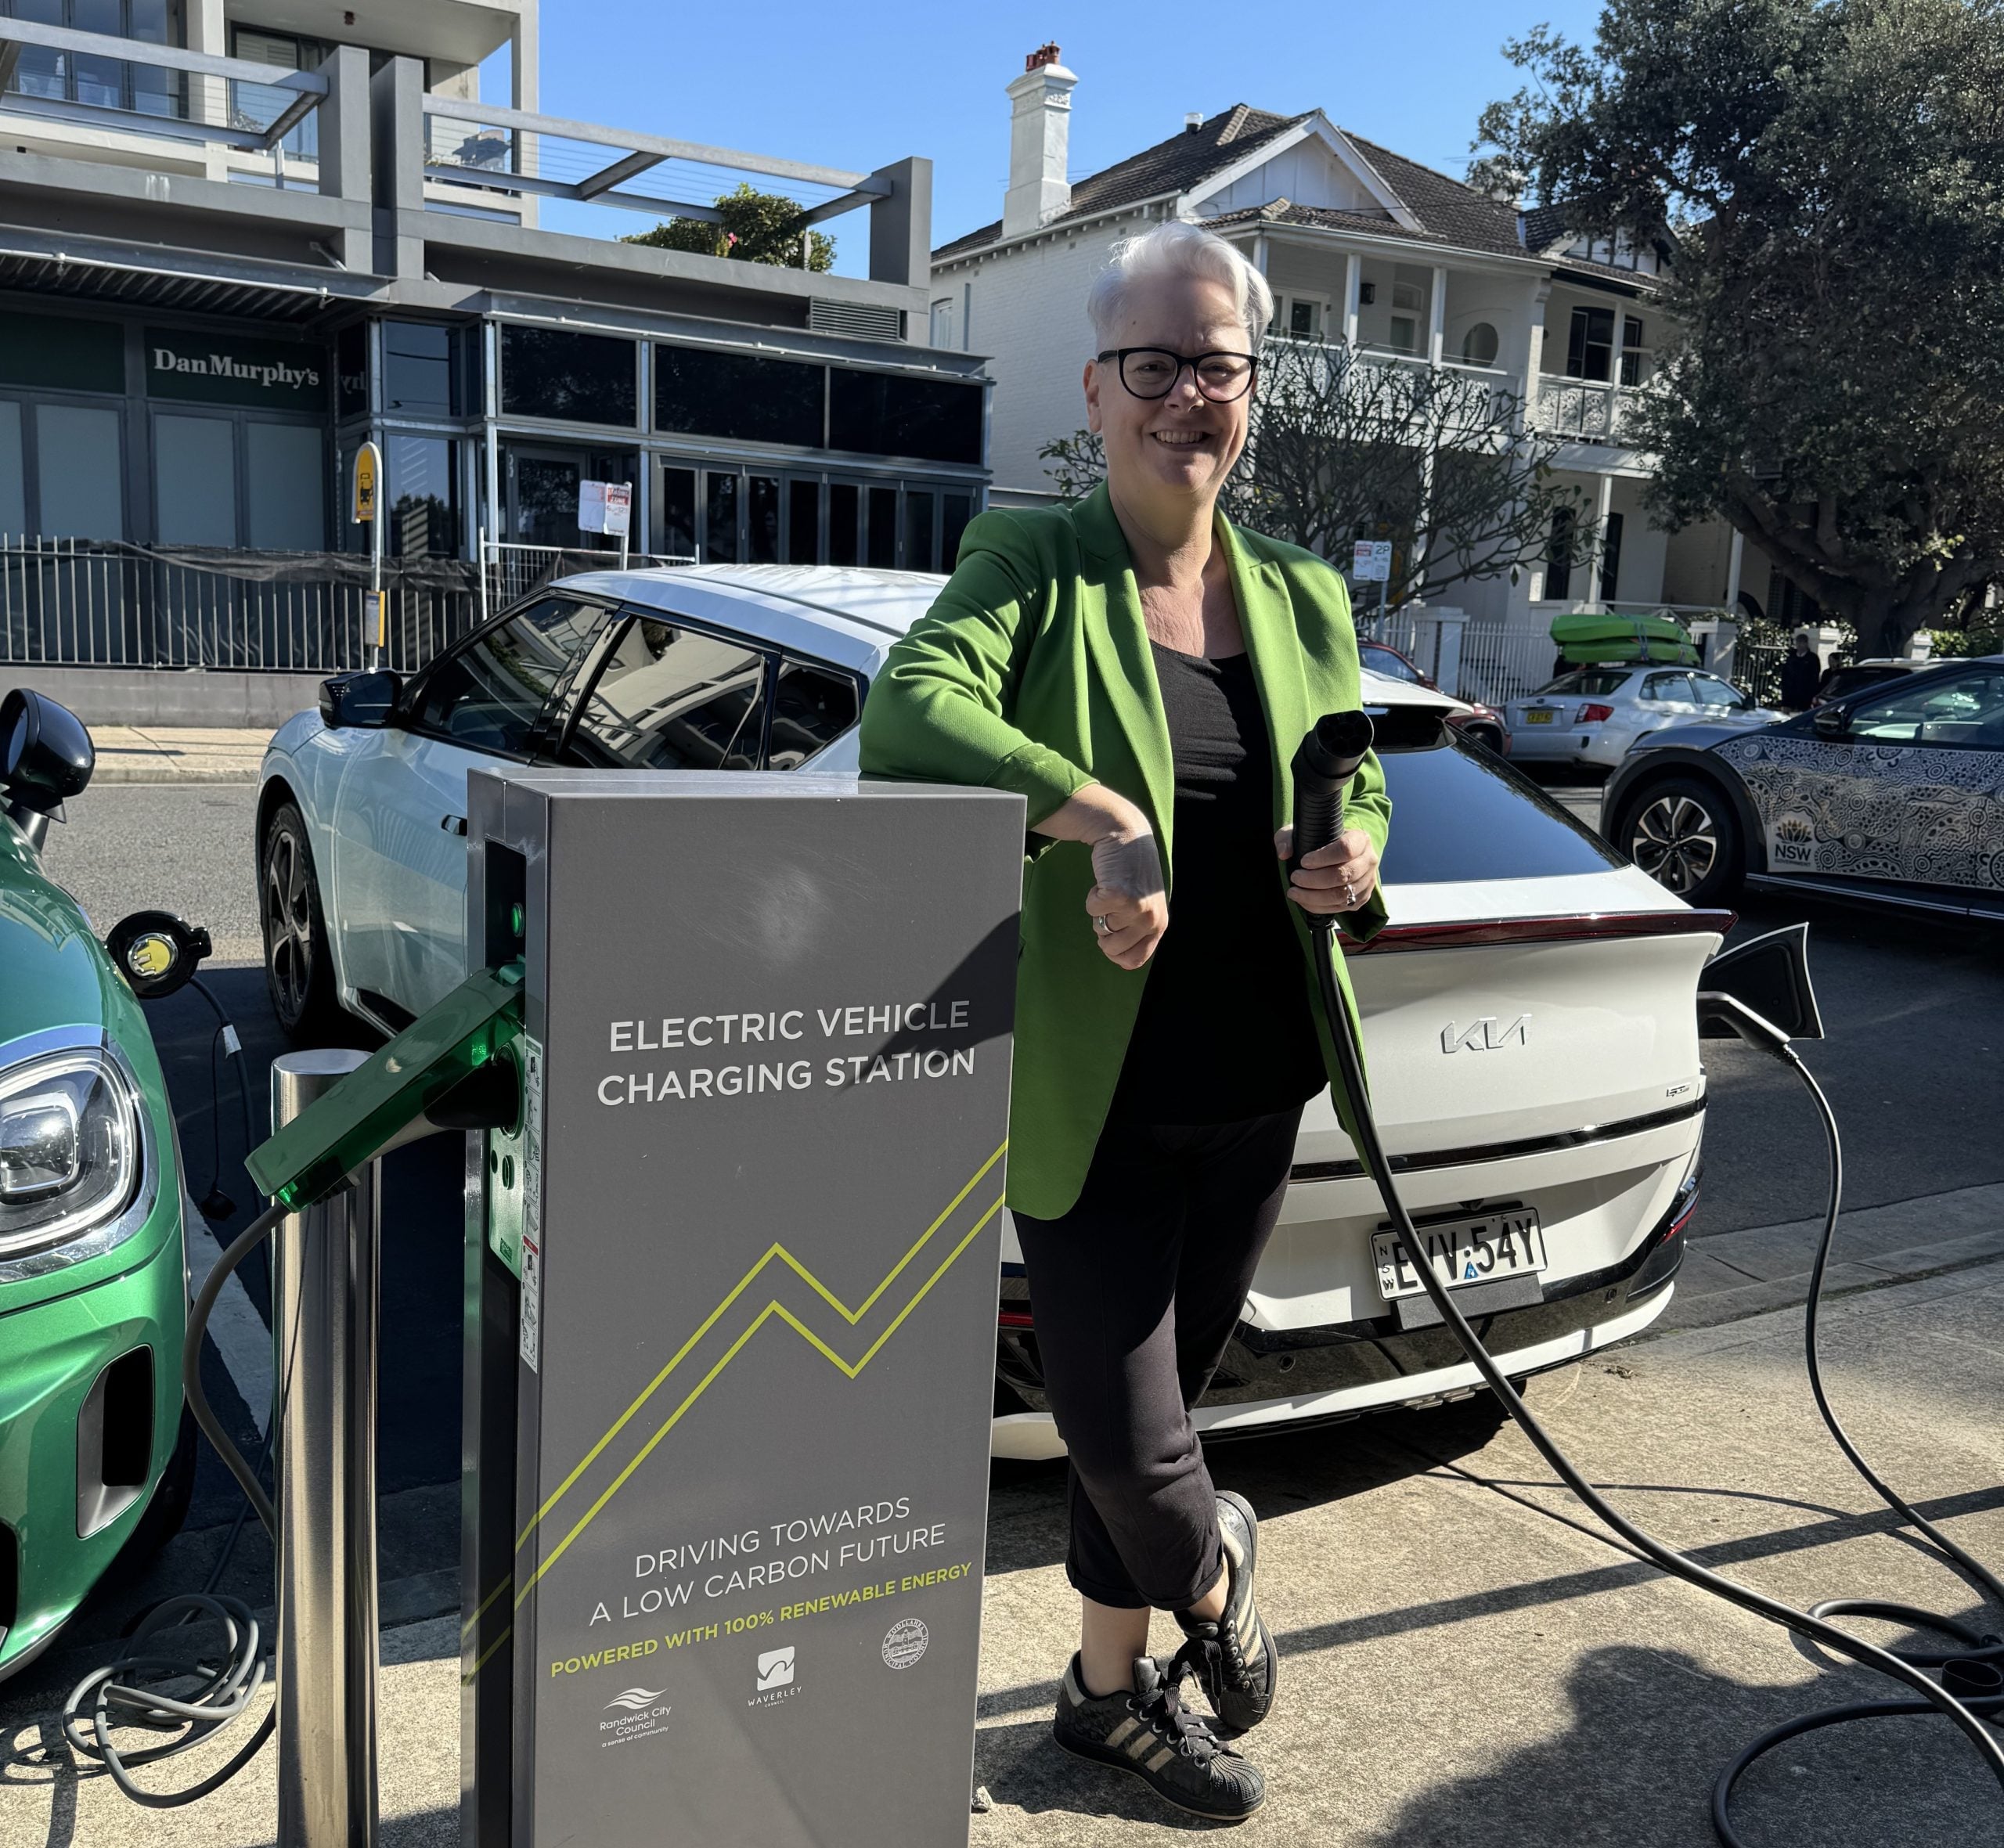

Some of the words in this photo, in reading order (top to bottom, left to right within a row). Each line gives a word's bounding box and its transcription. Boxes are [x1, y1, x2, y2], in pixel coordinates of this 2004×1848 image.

[1375, 545, 1390, 555] 2P
[1775, 844, 1811, 861] NSW
[610, 1010, 804, 1052] ELECTRIC
[817, 1000, 970, 1036] VEHICLE
[1440, 1014, 1533, 1054] KIA
[598, 1061, 812, 1106] CHARGING
[825, 1047, 975, 1086] STATION
[636, 1530, 760, 1578] DRIVING
[770, 1497, 910, 1547] TOWARDS
[589, 1601, 611, 1626] A
[623, 1580, 694, 1619] LOW
[705, 1549, 829, 1598] CARBON
[839, 1522, 946, 1567] FUTURE
[551, 1639, 658, 1677] POWERED
[665, 1623, 719, 1649] WITH
[724, 1609, 774, 1635] 100%
[781, 1580, 896, 1622] RENEWABLE
[902, 1562, 972, 1592] ENERGY
[748, 1686, 802, 1706] WAVERLEY
[600, 1711, 650, 1731] Randwick
[651, 1706, 672, 1717] City
[616, 1719, 655, 1736] Council
[607, 1738, 625, 1746] sense
[633, 1726, 669, 1740] community
